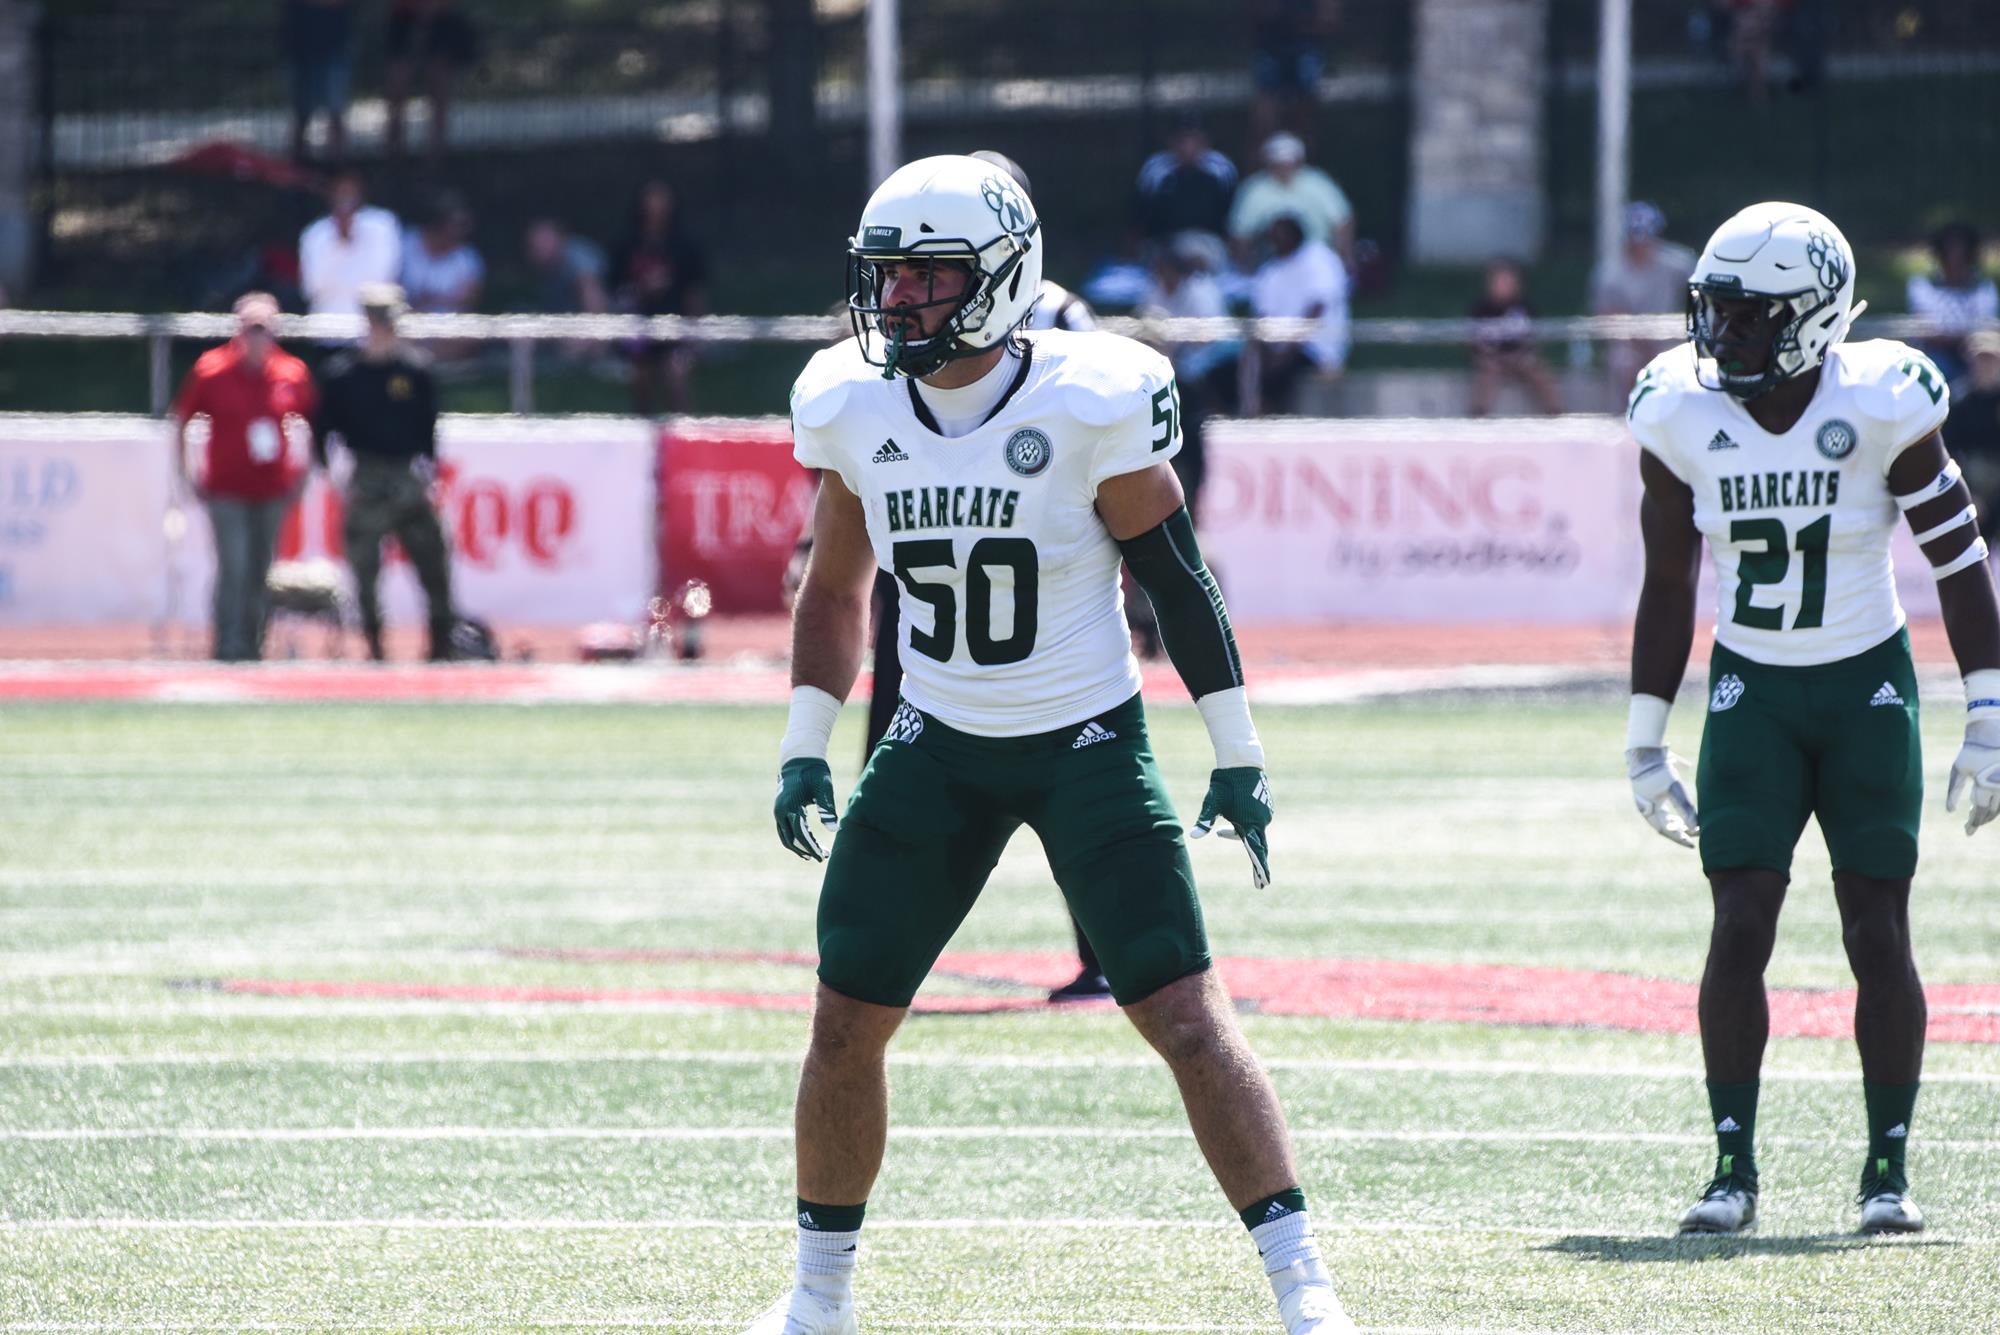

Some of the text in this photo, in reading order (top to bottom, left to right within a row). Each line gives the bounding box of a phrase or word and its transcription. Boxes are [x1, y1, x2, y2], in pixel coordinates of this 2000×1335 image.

[1004, 198, 1025, 231] N
[868, 228, 894, 237] FAMILY
[1827, 256, 1842, 285] N
[872, 453, 909, 463] adidas
[1719, 470, 1840, 513] BEARCATS
[885, 486, 1020, 533] BEARCATS
[1730, 513, 1831, 631] 21
[892, 537, 1039, 666] 50
[891, 723, 910, 739] N
[1072, 731, 1117, 749] adidas
[1263, 1207, 1292, 1223] adidas
